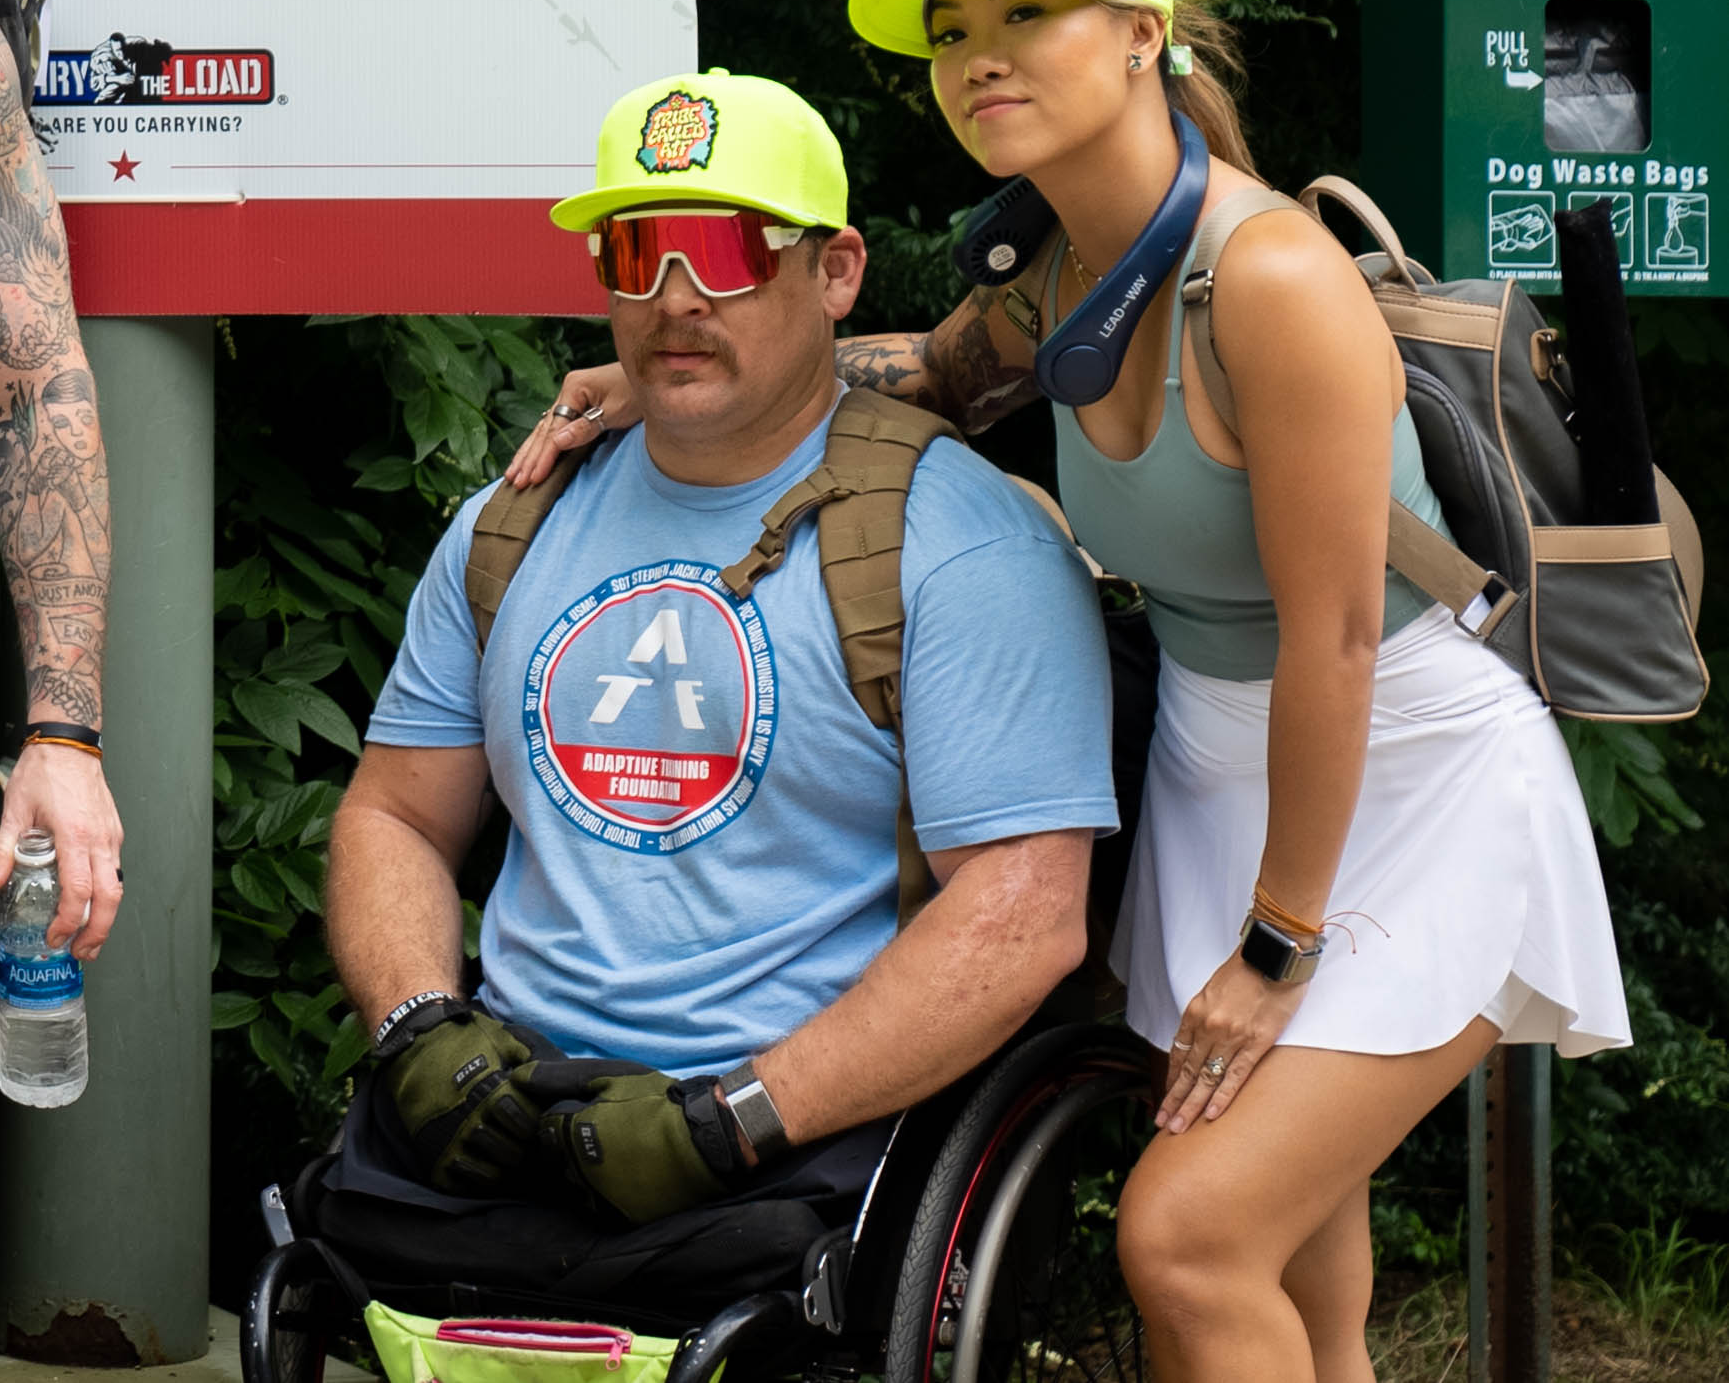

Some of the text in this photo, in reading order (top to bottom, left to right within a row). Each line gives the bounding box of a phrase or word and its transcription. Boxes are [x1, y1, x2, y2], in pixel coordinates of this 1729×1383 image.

[1486, 30, 1530, 54] PULL
[140, 58, 264, 96] THE LOAD
[53, 117, 241, 134] ARE YOU CARRYING?
[653, 104, 701, 130] TRIBE
[647, 122, 706, 146] CALLED
[1487, 158, 1710, 190] Dog Waste Bags
[1099, 273, 1148, 338] LEAD WAY
[528, 653, 548, 690] JASON
[567, 595, 598, 622] USMC
[745, 616, 768, 654] TRAVIS
[755, 719, 774, 736] US
[582, 752, 659, 777] ADAPTIVE
[748, 735, 770, 768] NAVY
[603, 823, 642, 849] TREVOR
[9, 962, 74, 986] AQUAFINA
